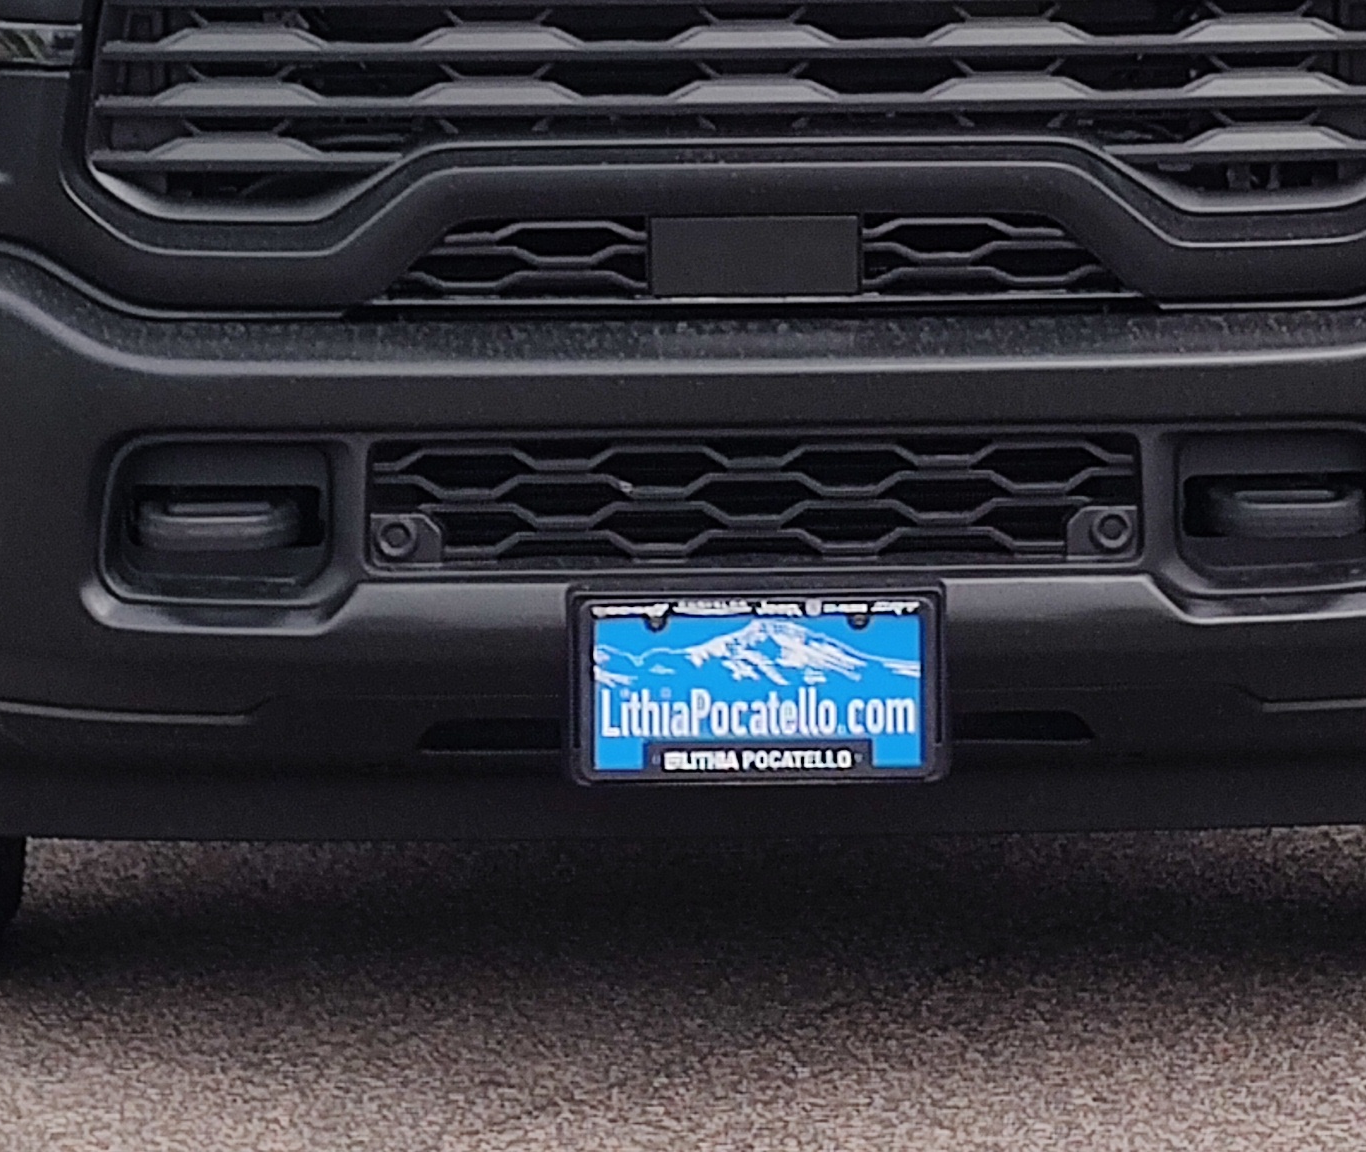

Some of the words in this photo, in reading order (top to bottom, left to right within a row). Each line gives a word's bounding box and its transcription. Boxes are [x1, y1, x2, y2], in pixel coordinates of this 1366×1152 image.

[601, 687, 915, 737] LithiaPocatello.com
[683, 750, 739, 770] LITHIA
[742, 750, 852, 769] POCATELLO
